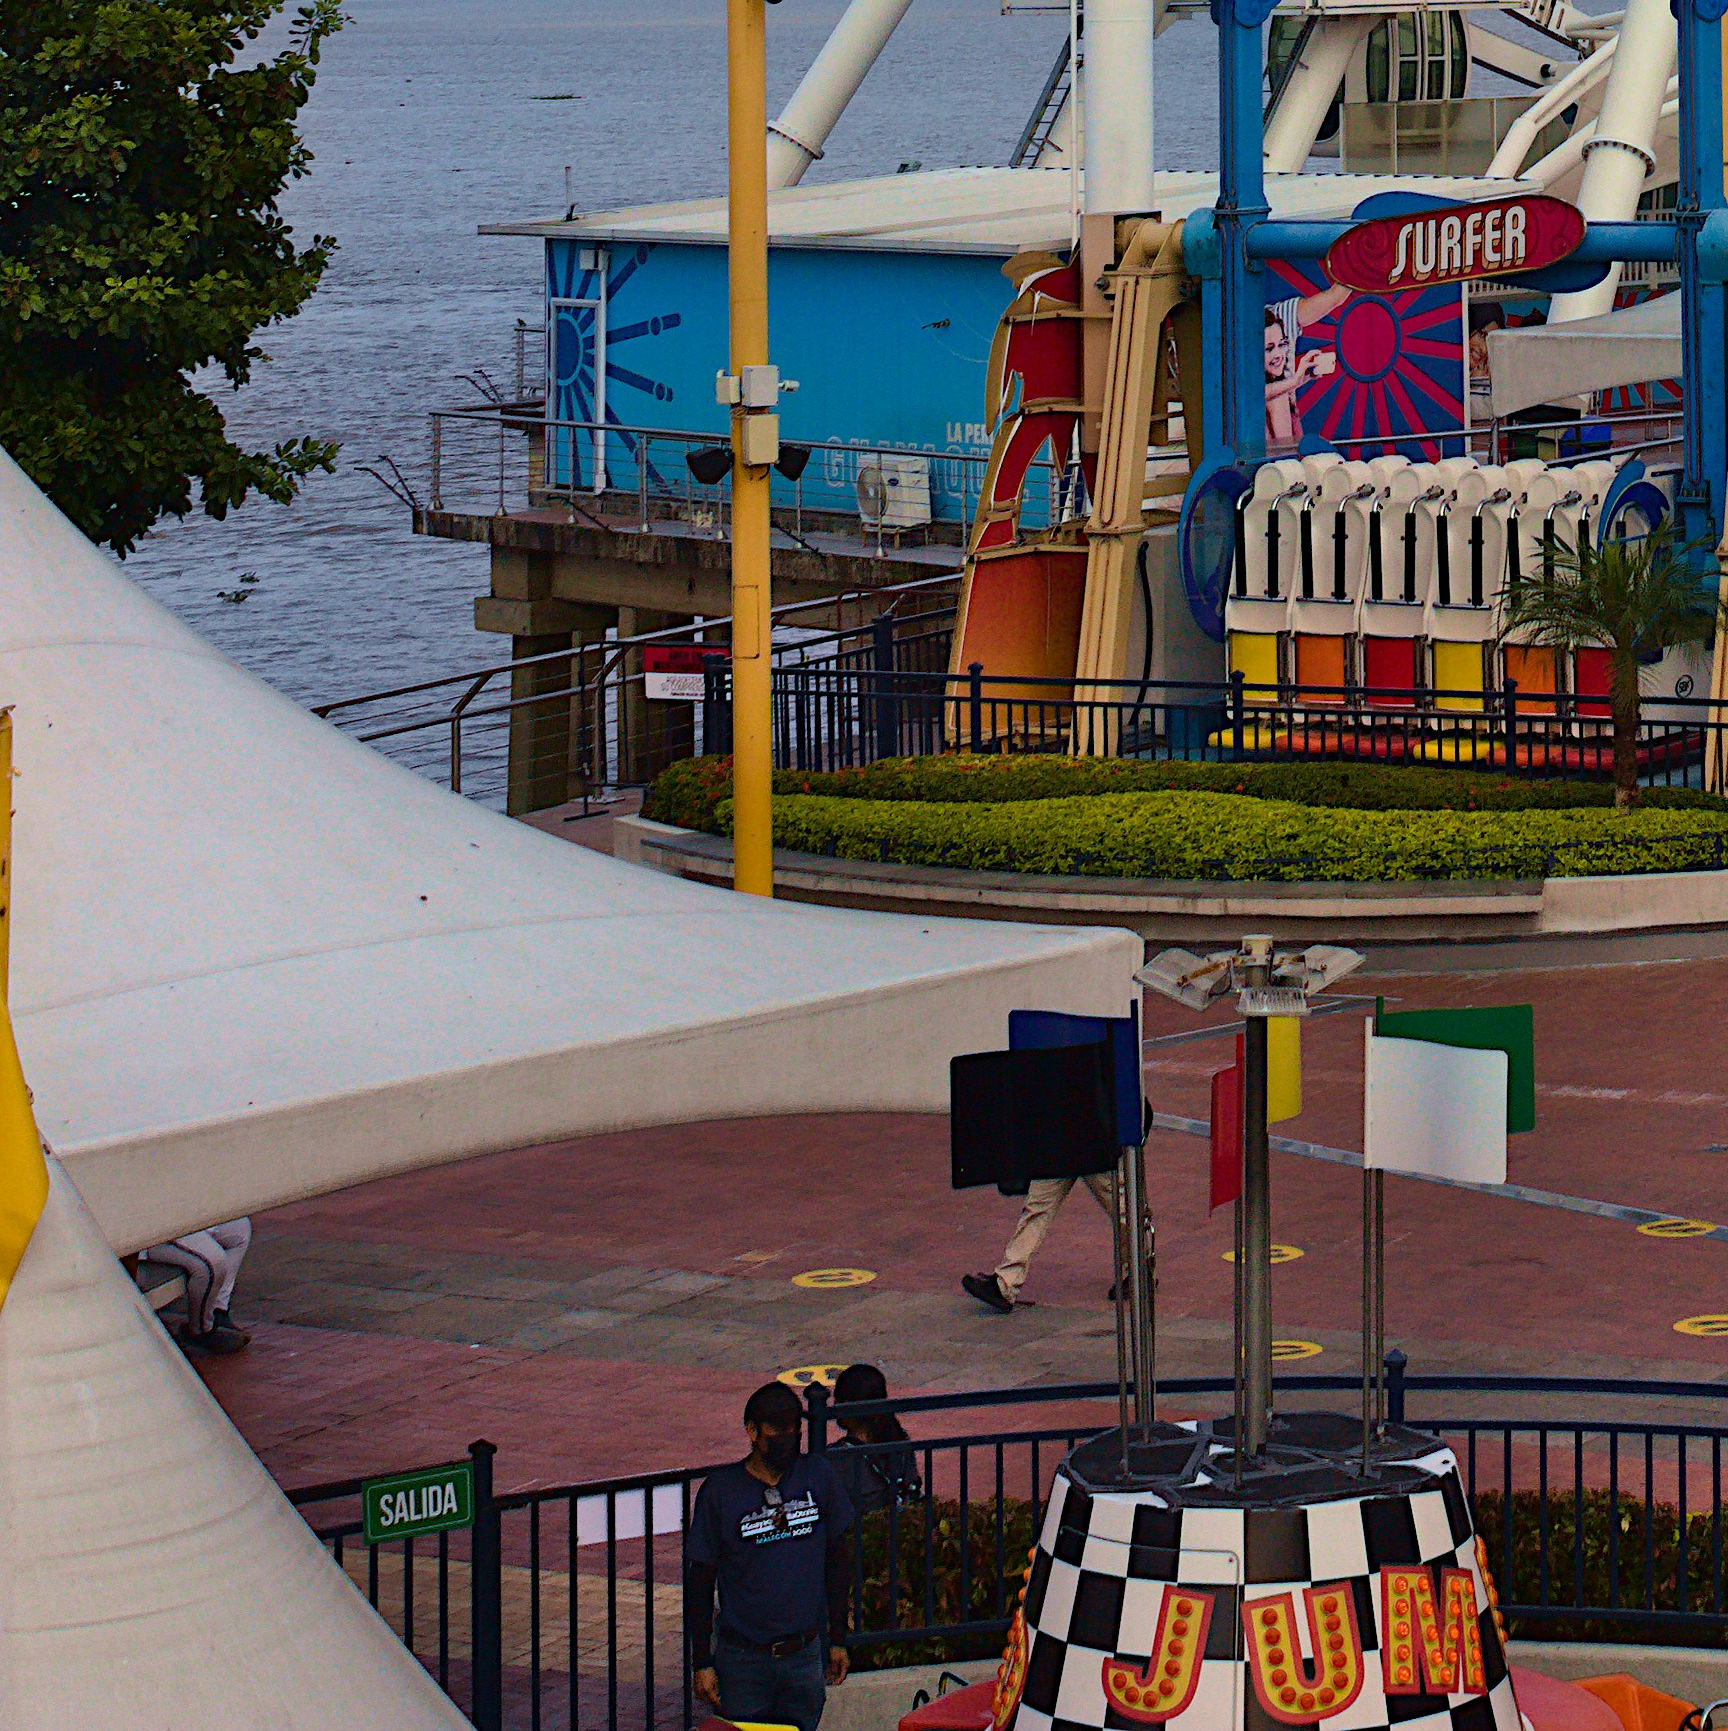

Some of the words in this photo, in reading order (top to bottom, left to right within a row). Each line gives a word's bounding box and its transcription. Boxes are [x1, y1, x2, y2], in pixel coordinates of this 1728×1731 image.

[1388, 205, 1527, 285] SURFER
[946, 421, 963, 443] LA
[965, 423, 994, 446] PER
[379, 1481, 458, 1527] SALIDA
